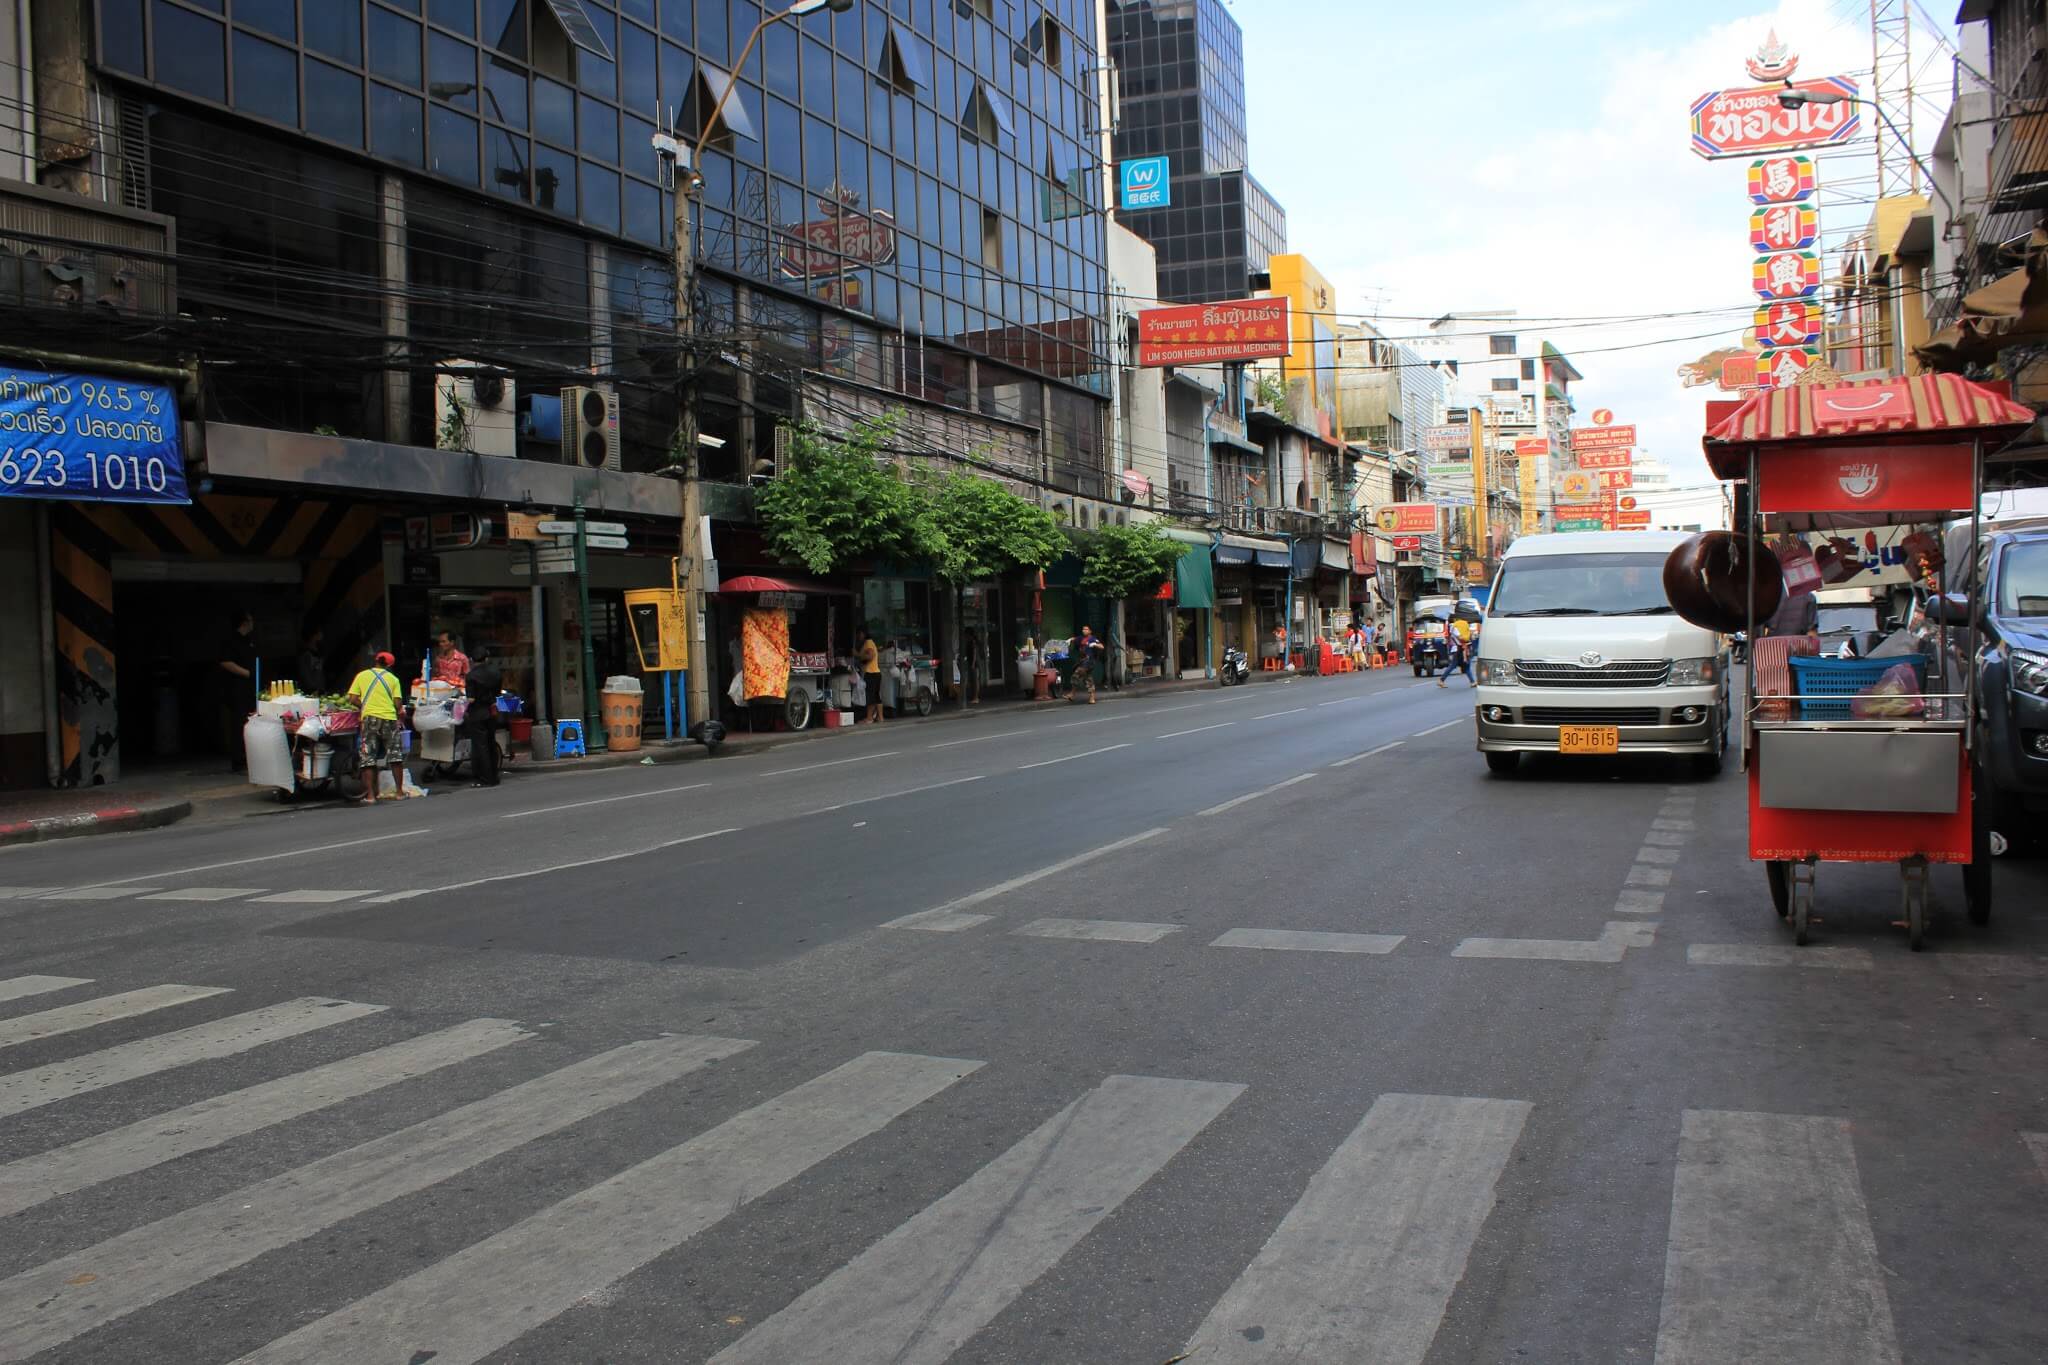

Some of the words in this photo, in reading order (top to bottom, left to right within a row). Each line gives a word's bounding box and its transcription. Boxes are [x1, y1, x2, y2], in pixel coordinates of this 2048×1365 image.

[1134, 167, 1154, 183] W
[1147, 352, 1160, 361] LIM
[1162, 350, 1183, 360] SOON
[1184, 348, 1206, 358] HENG
[1207, 346, 1241, 357] NATURAL
[1243, 343, 1282, 352] MEDICINE
[81, 382, 133, 411] 96.5
[0, 407, 67, 435] วดเร็ว
[75, 413, 163, 443] ปลอดภัย
[85, 451, 167, 493] 1010
[1563, 732, 1615, 746] 30-1615
